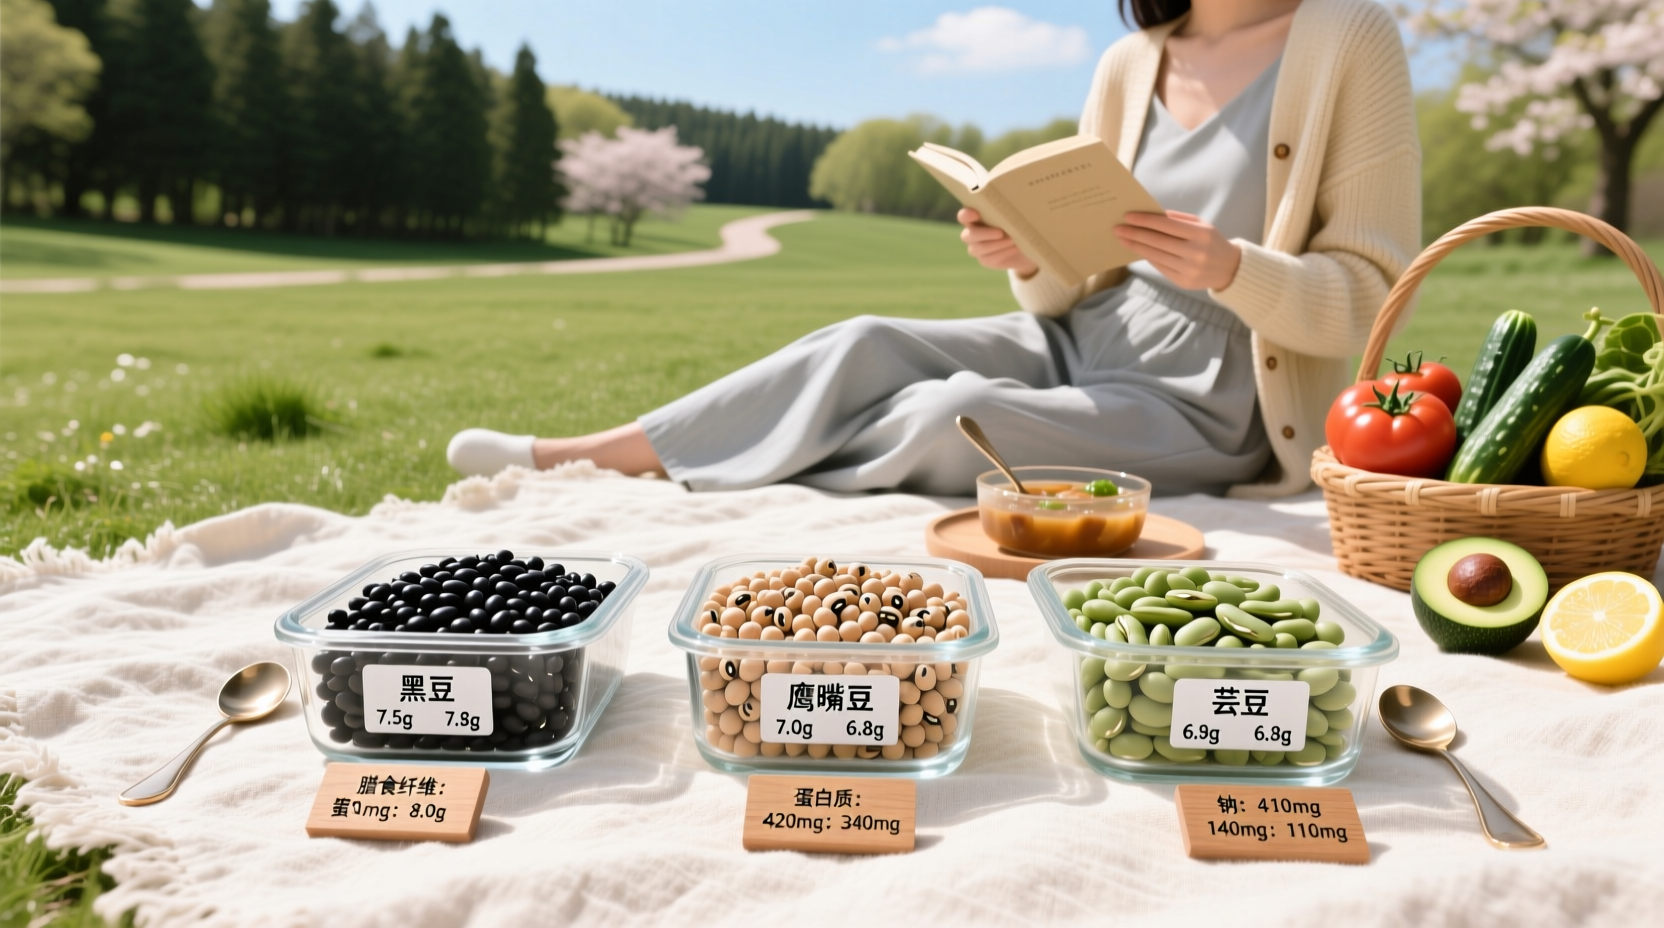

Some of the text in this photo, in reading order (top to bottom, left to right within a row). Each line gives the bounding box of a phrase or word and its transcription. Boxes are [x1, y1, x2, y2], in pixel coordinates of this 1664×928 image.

[399, 674, 455, 703] 黑豆
[786, 681, 874, 713] 鹰嘴豆
[1211, 686, 1269, 717] 芸豆
[376, 709, 413, 731] 7.5g
[776, 718, 885, 742] 7.0g 6.8g
[1182, 723, 1292, 747] 6.9g 6.8g
[409, 802, 447, 823] 8.0g
[1257, 797, 1322, 819] 410mg
[840, 814, 901, 836] 340mg
[1286, 822, 1349, 844] 110mg
